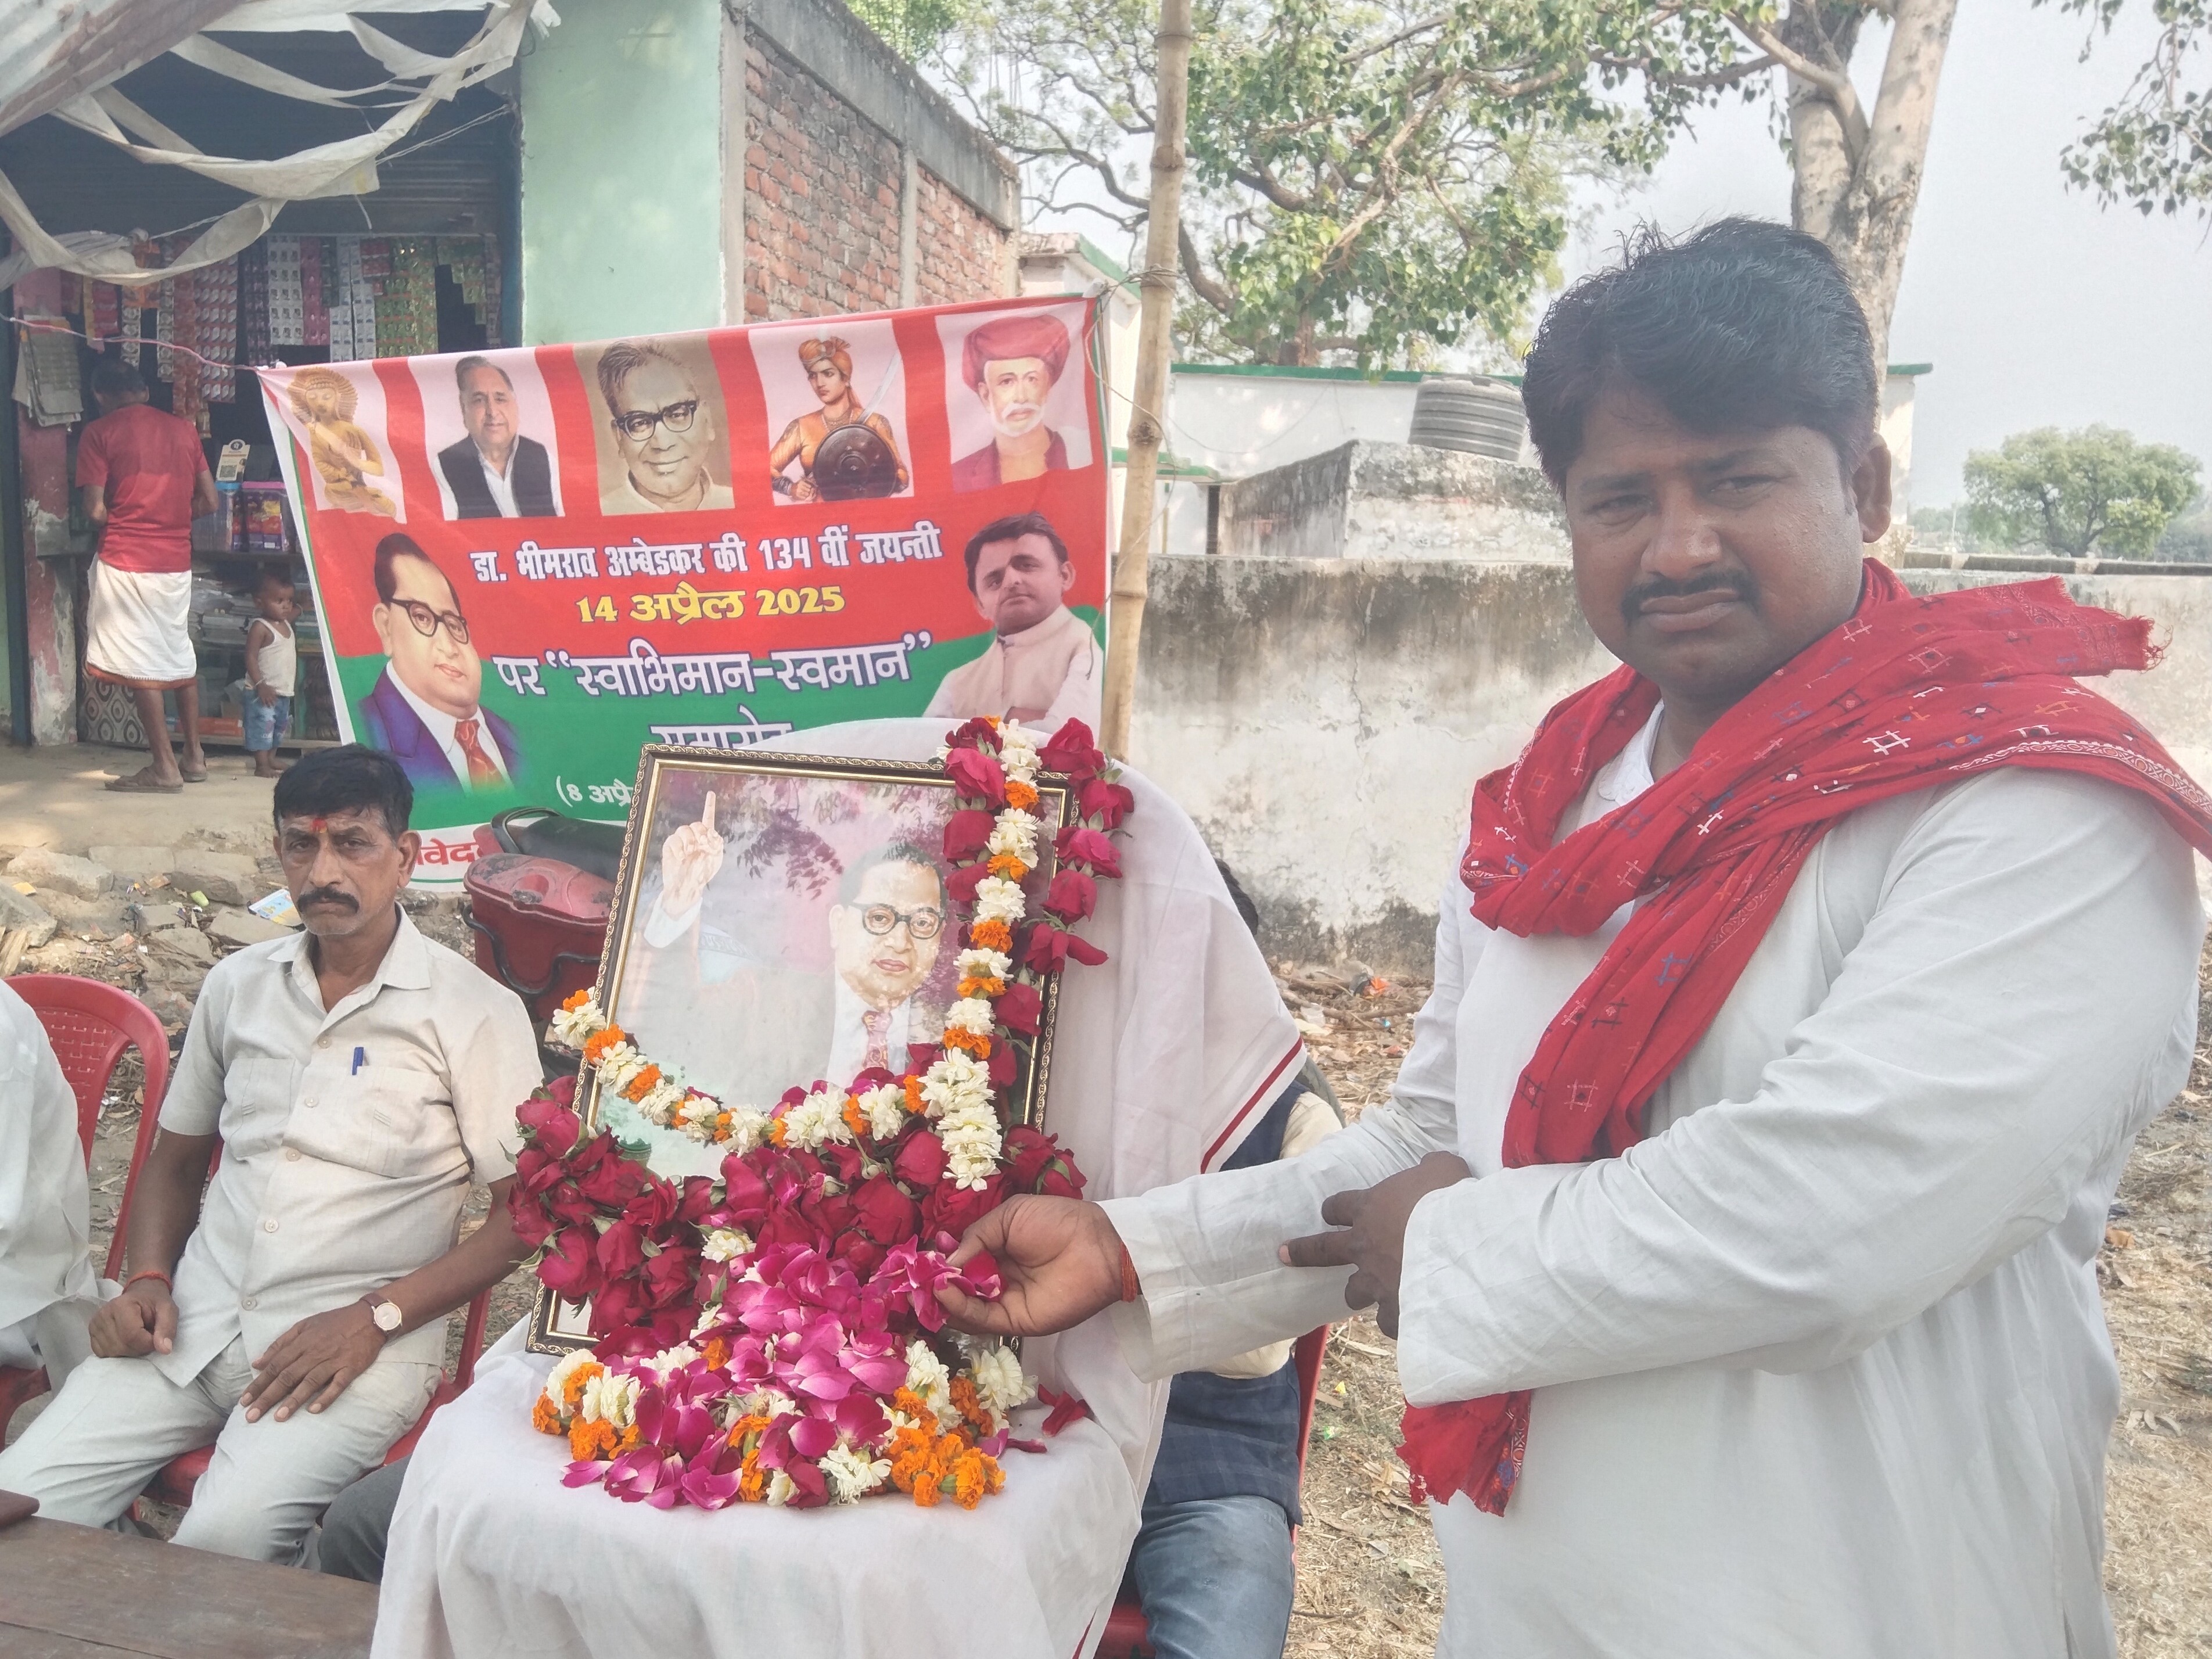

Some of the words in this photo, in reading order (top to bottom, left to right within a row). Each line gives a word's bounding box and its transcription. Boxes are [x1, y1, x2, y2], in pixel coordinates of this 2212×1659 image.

[469, 551, 508, 581] डा.
[515, 540, 599, 580] भीमराव
[604, 537, 706, 577] अम्बेडकर
[709, 531, 748, 573] की
[758, 537, 813, 570] 134
[817, 525, 850, 567] वीं
[854, 519, 943, 564] जयन्ती
[575, 595, 618, 623] 14
[629, 580, 746, 626] अप्रैल
[755, 586, 846, 616] 2025
[491, 655, 547, 696] पर
[588, 778, 633, 807] अप्रै
